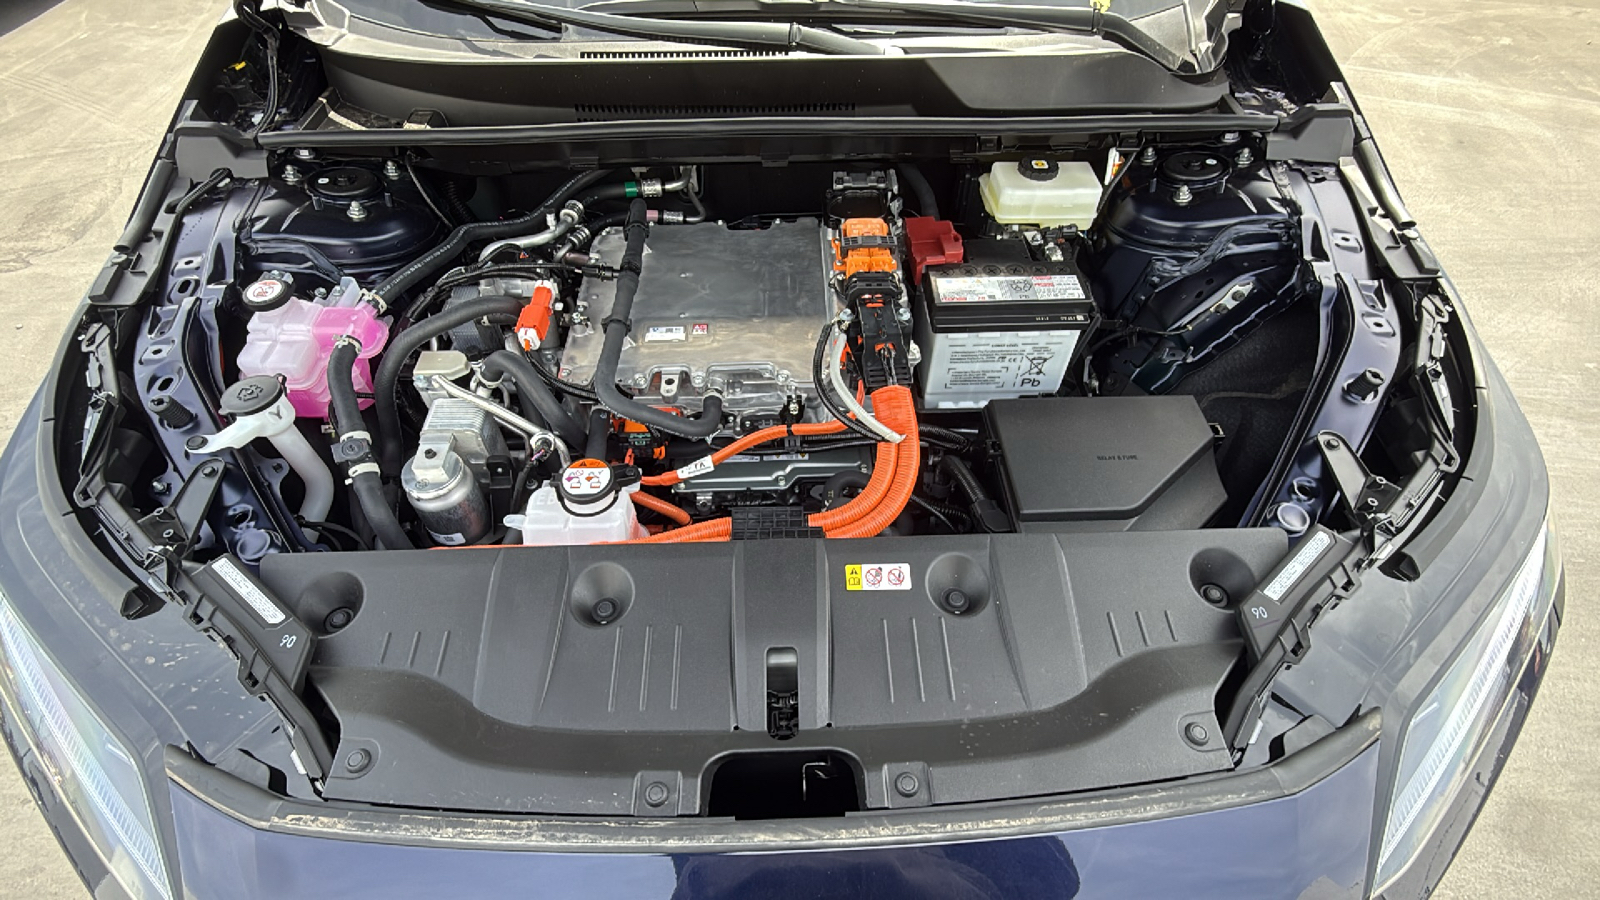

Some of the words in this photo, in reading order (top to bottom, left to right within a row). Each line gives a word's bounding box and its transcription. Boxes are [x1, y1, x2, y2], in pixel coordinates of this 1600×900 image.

[1020, 378, 1041, 387] Pb
[1251, 606, 1268, 619] 90
[279, 634, 297, 648] 90
